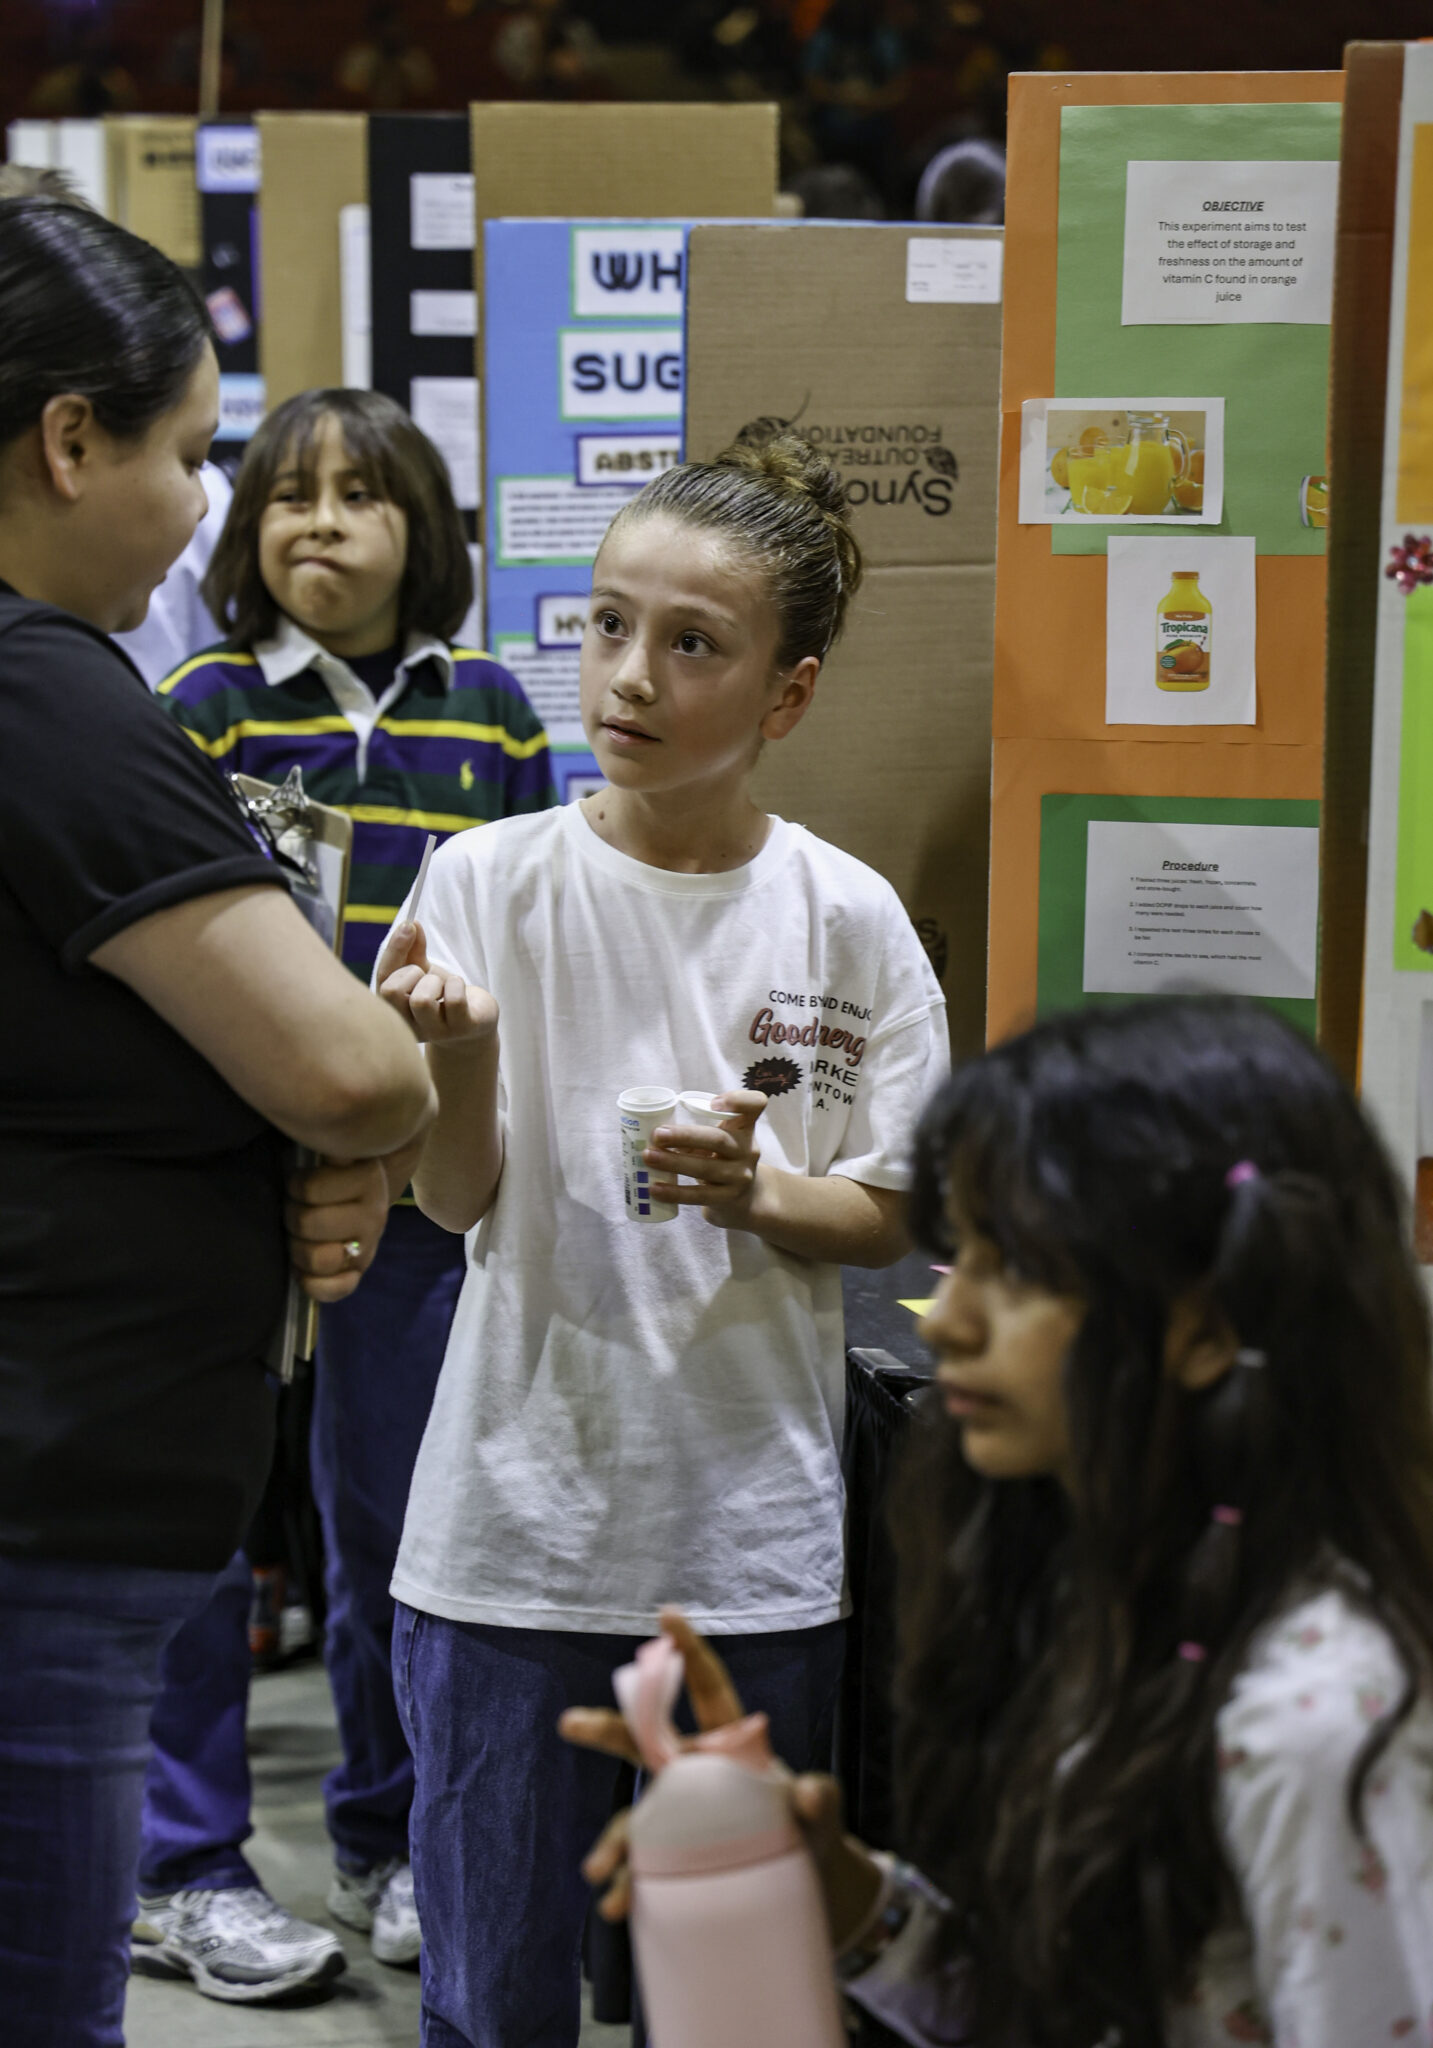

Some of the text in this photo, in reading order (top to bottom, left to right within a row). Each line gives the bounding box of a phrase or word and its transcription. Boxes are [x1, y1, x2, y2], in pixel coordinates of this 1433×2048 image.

[1202, 201, 1265, 212] OBJECTIVE
[1158, 221, 1307, 233] This experiment aims to test
[1167, 239, 1296, 251] the effect of storage and
[1158, 256, 1304, 267] freshness on the amount of
[1162, 274, 1298, 286] vitamin C found in orange
[1215, 292, 1242, 303] juice
[1160, 622, 1208, 634] Tropicana
[1162, 860, 1220, 872] Procedure
[769, 990, 805, 1007] COME
